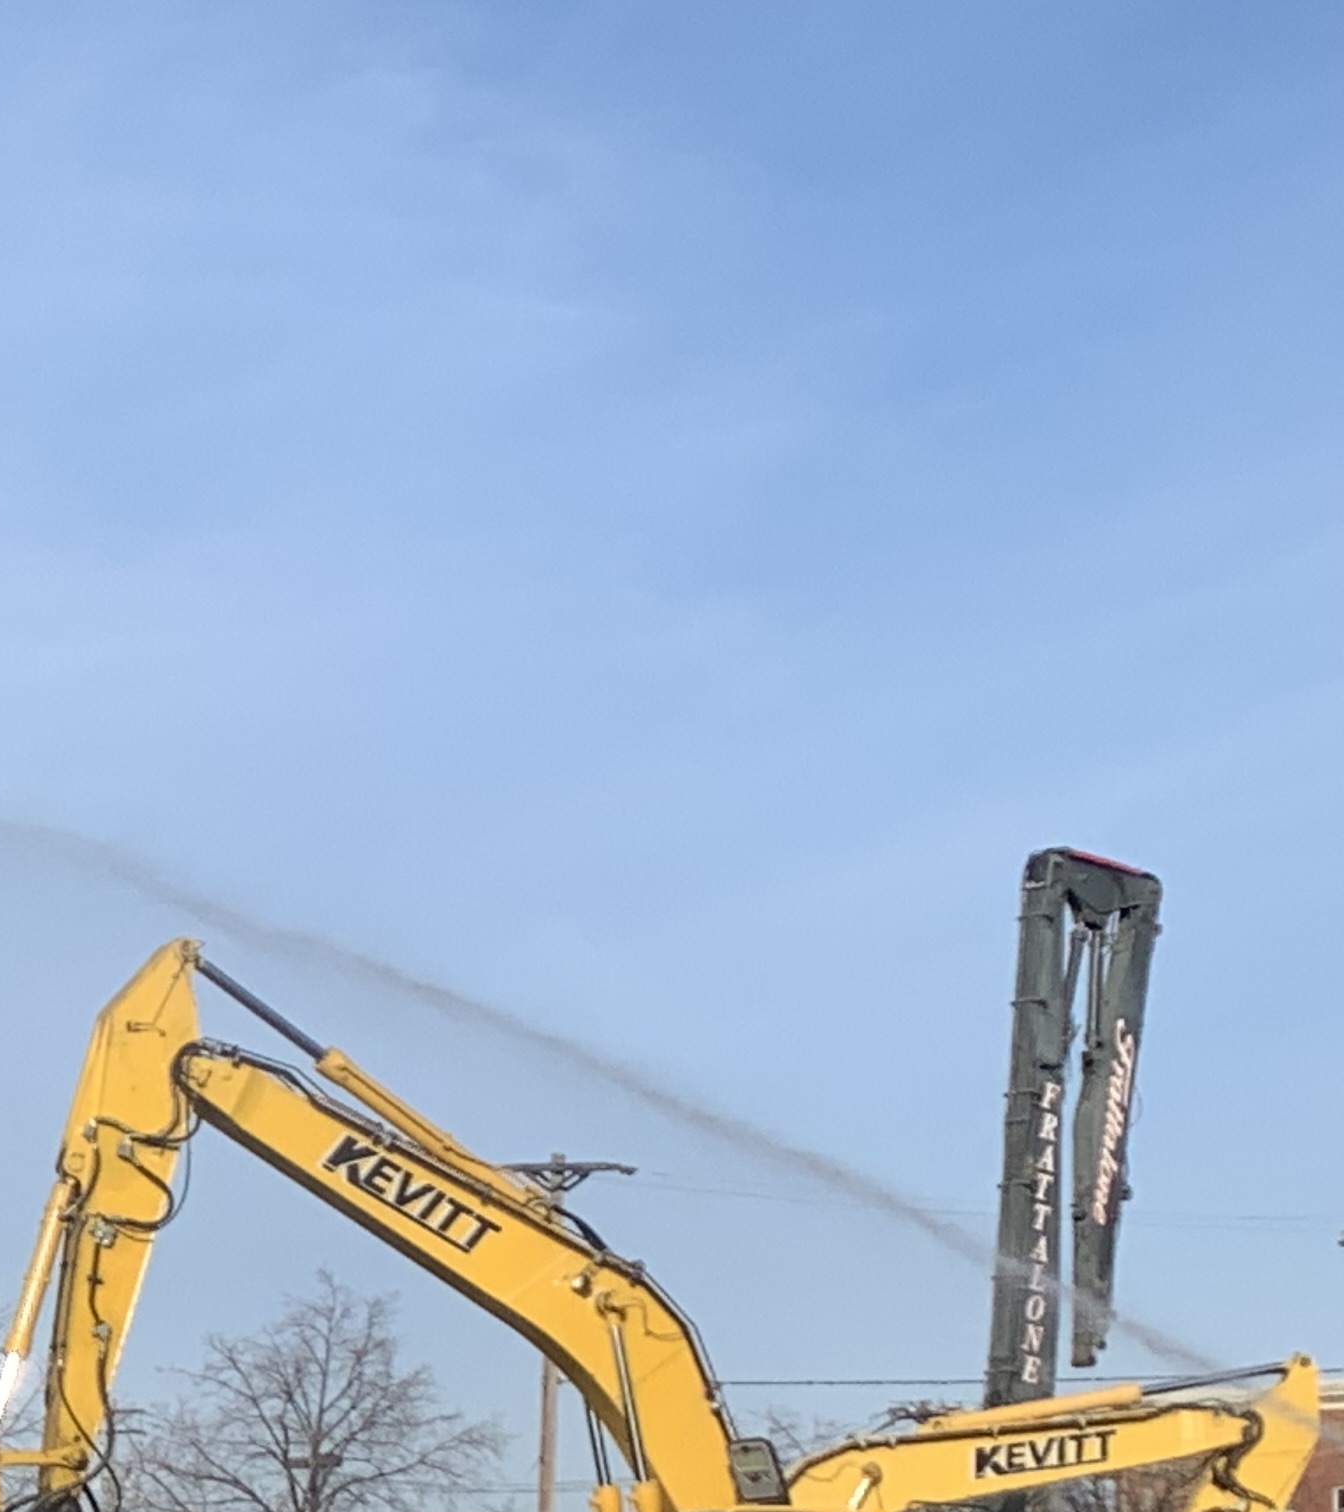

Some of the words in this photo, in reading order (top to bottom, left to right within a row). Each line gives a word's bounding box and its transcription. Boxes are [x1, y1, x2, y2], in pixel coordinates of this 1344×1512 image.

[322, 1134, 502, 1253] KEVITT
[1021, 1080, 1062, 1385] FRATTALONE
[974, 1429, 1117, 1479] KEVITT
